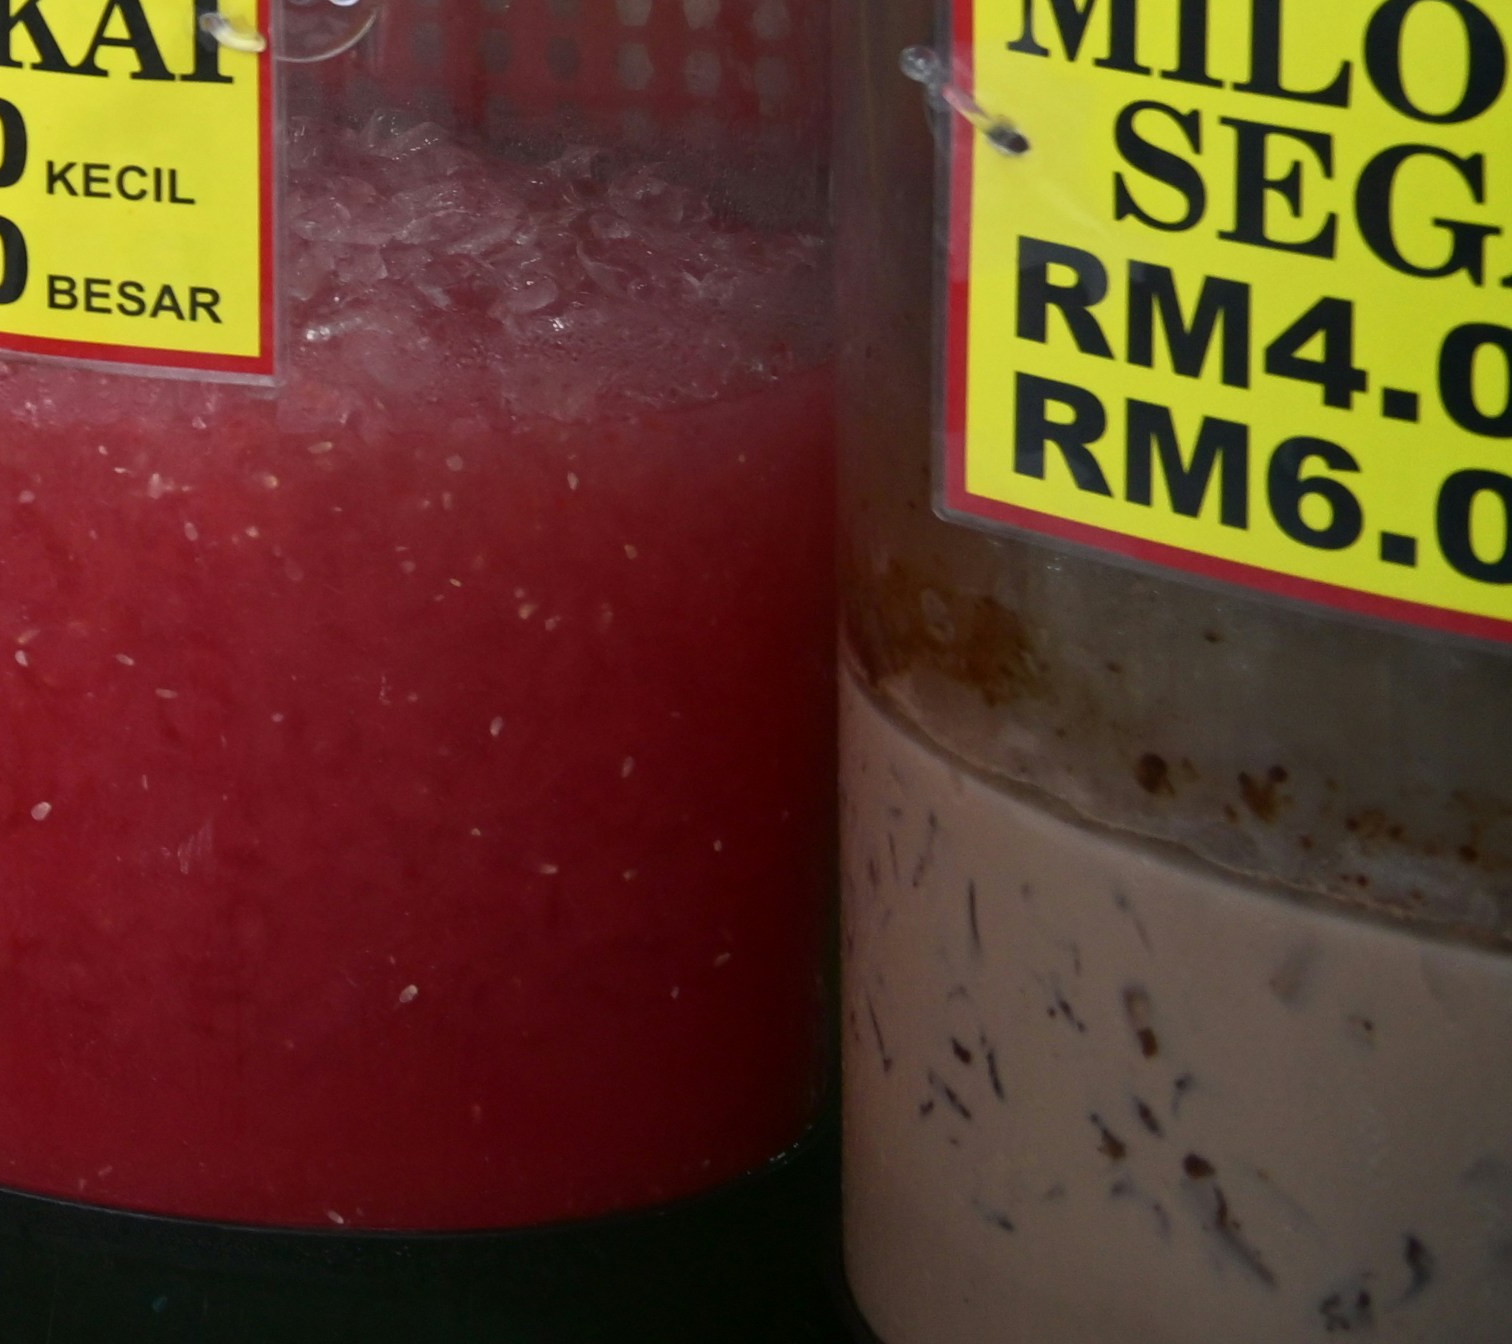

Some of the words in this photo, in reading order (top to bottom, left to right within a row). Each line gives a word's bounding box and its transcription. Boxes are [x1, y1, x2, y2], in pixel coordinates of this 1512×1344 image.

[45, 159, 196, 206] KECIL
[1112, 99, 1512, 289] SEG
[46, 274, 223, 325] BESAR
